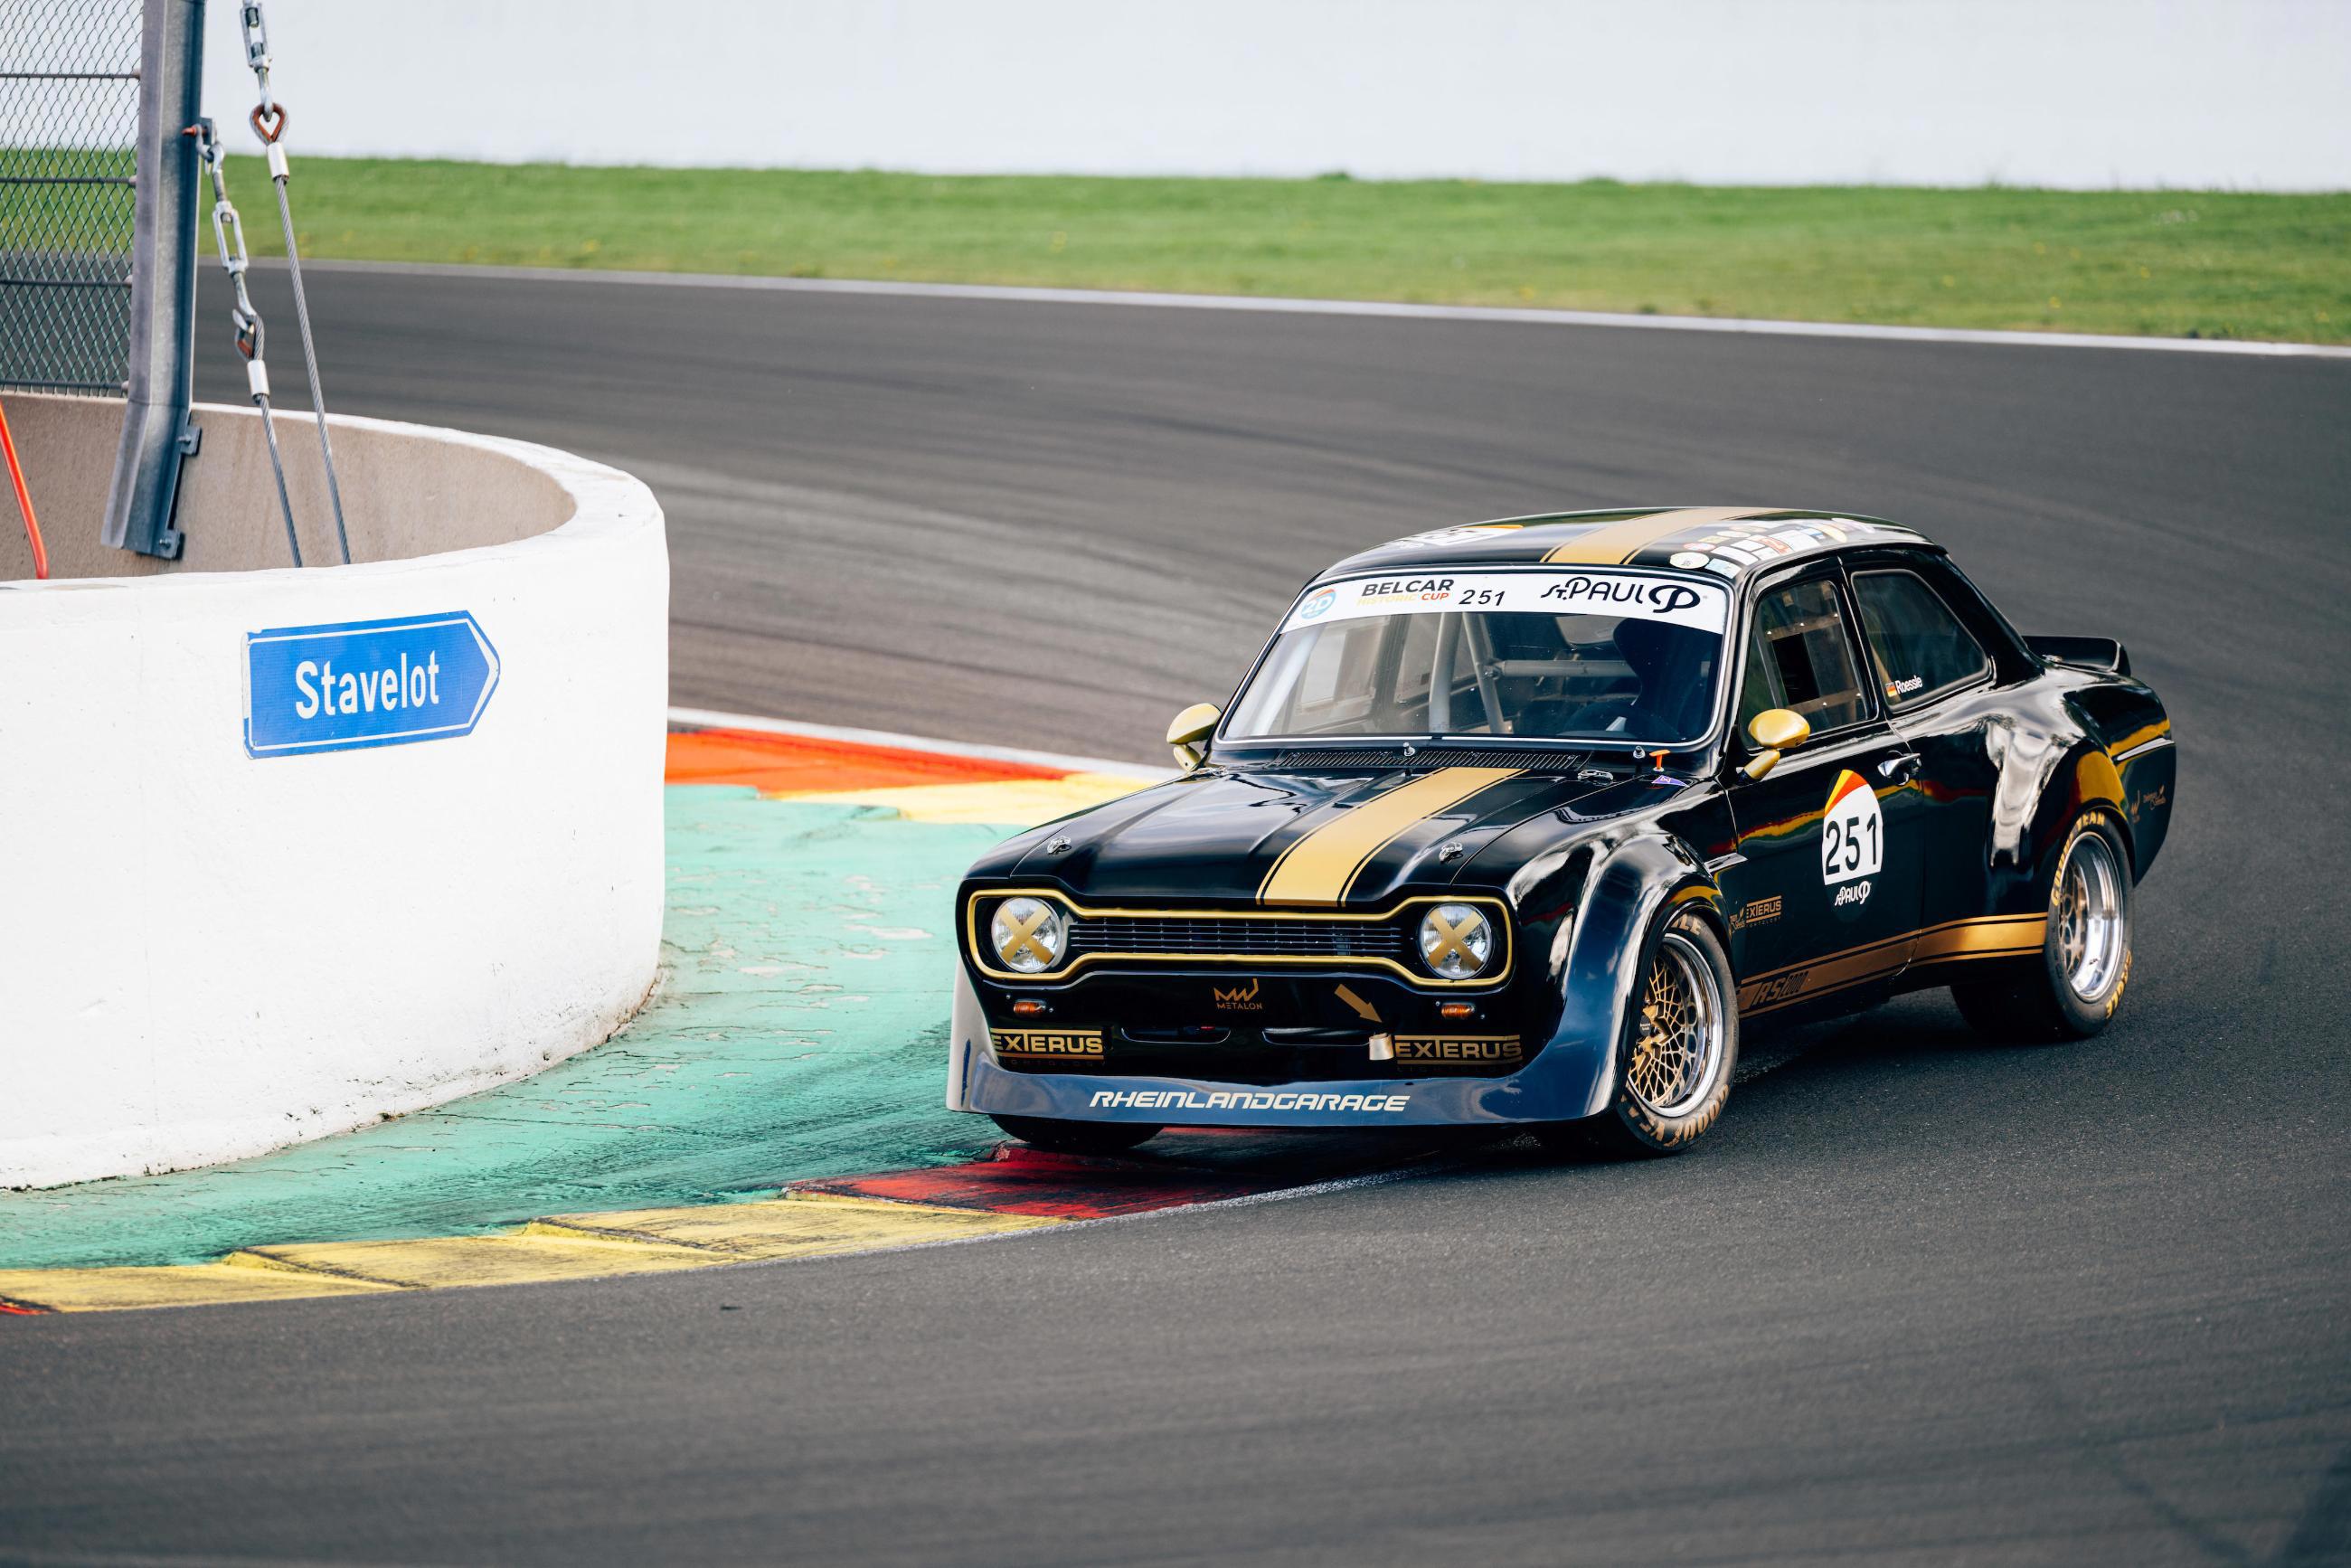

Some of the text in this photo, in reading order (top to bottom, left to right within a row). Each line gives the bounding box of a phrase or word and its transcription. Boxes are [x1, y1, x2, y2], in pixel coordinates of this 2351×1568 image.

[1361, 579, 1455, 597] BELCAR
[1421, 592, 1449, 601] CUP
[1459, 589, 1506, 607] 251
[295, 650, 439, 719] Stavelot
[1825, 812, 1880, 876] 251
[990, 1028, 1103, 1053] EXTERUS
[1394, 1034, 1522, 1059] EXTERUS
[1089, 1091, 1411, 1112] RHEINLANDGARAGE
